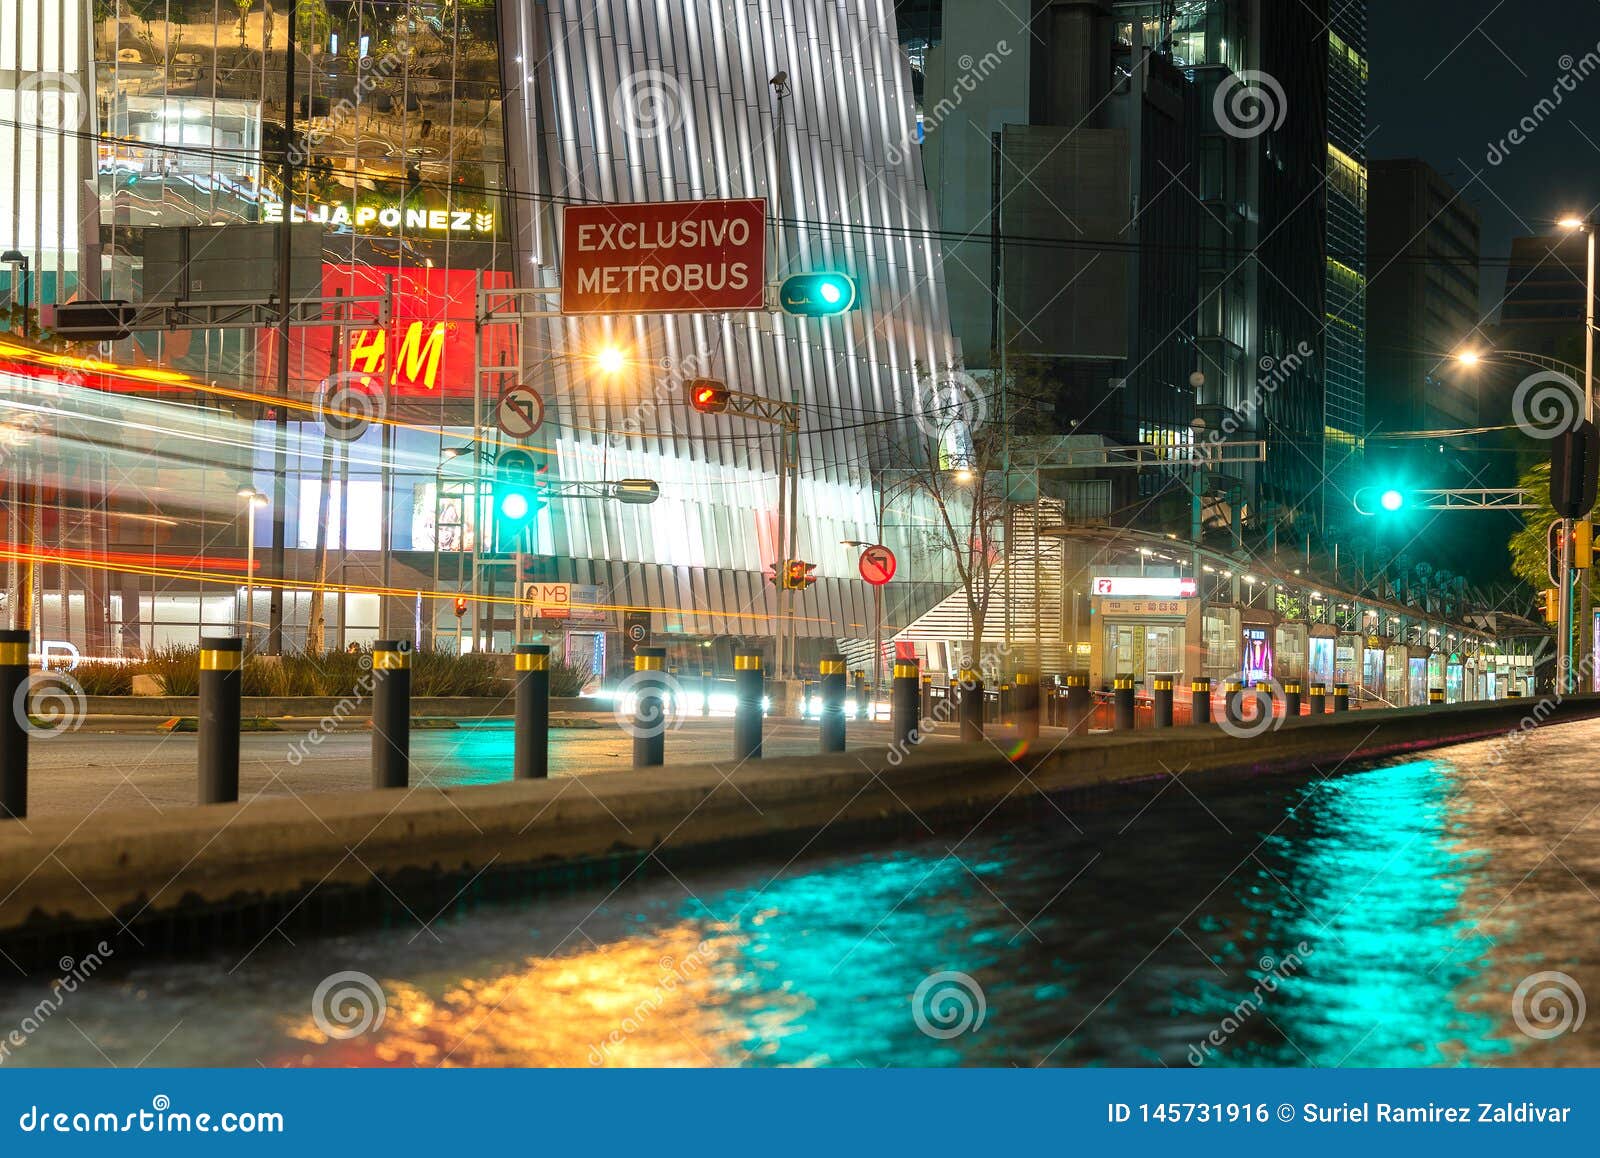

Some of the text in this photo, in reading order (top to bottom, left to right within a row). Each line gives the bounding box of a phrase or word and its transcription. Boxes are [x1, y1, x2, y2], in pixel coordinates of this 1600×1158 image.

[309, 205, 472, 231] JAPONEZ
[578, 218, 750, 252] EXCLUSIVO
[577, 262, 749, 295] METROBUS
[543, 585, 568, 603] MB
